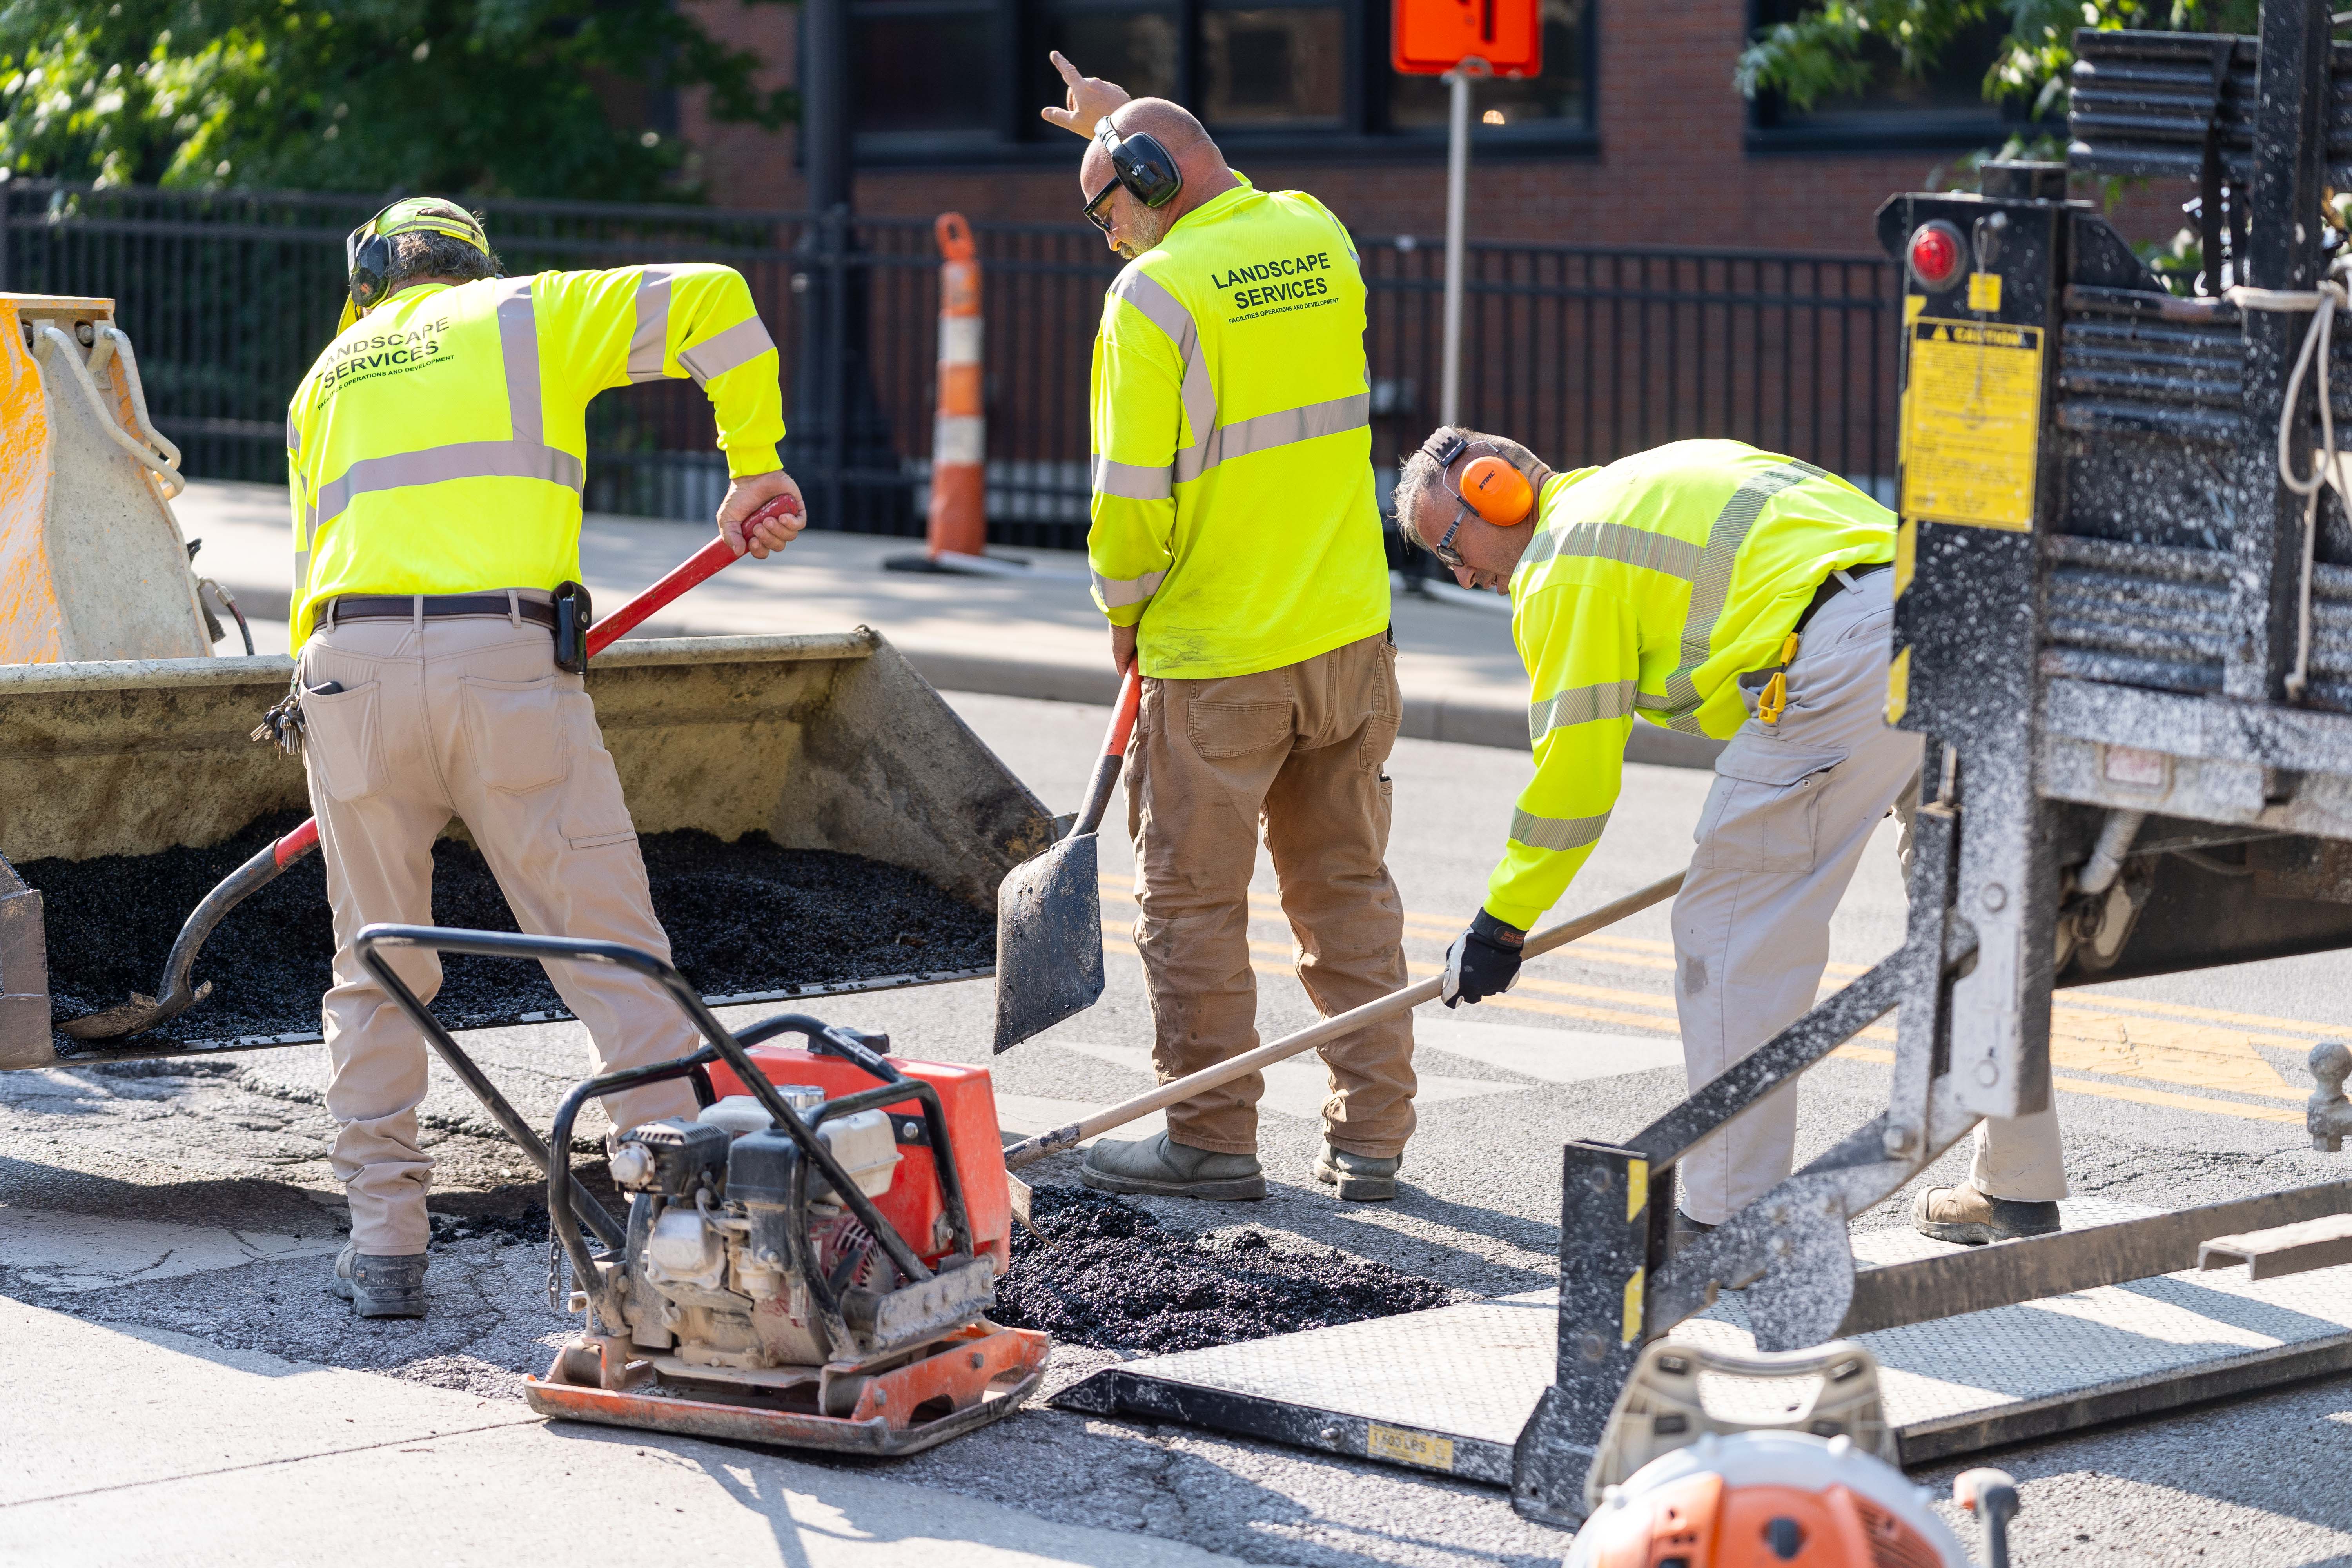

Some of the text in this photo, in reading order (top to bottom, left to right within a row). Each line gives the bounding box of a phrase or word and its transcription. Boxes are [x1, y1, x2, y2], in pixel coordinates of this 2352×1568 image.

[1211, 252, 1331, 289] LANDSCAPE
[1234, 277, 1327, 309] SERVICES
[1229, 312, 1259, 324] FACILITIES
[1260, 306, 1292, 317] OPERATIONS
[1304, 298, 1339, 309] DEVELOPMENT
[324, 341, 439, 389] SERVICES
[344, 371, 387, 387] OPERATIONS
[405, 354, 455, 372] DEVELOPMENT
[1479, 472, 1495, 490] STIHL
